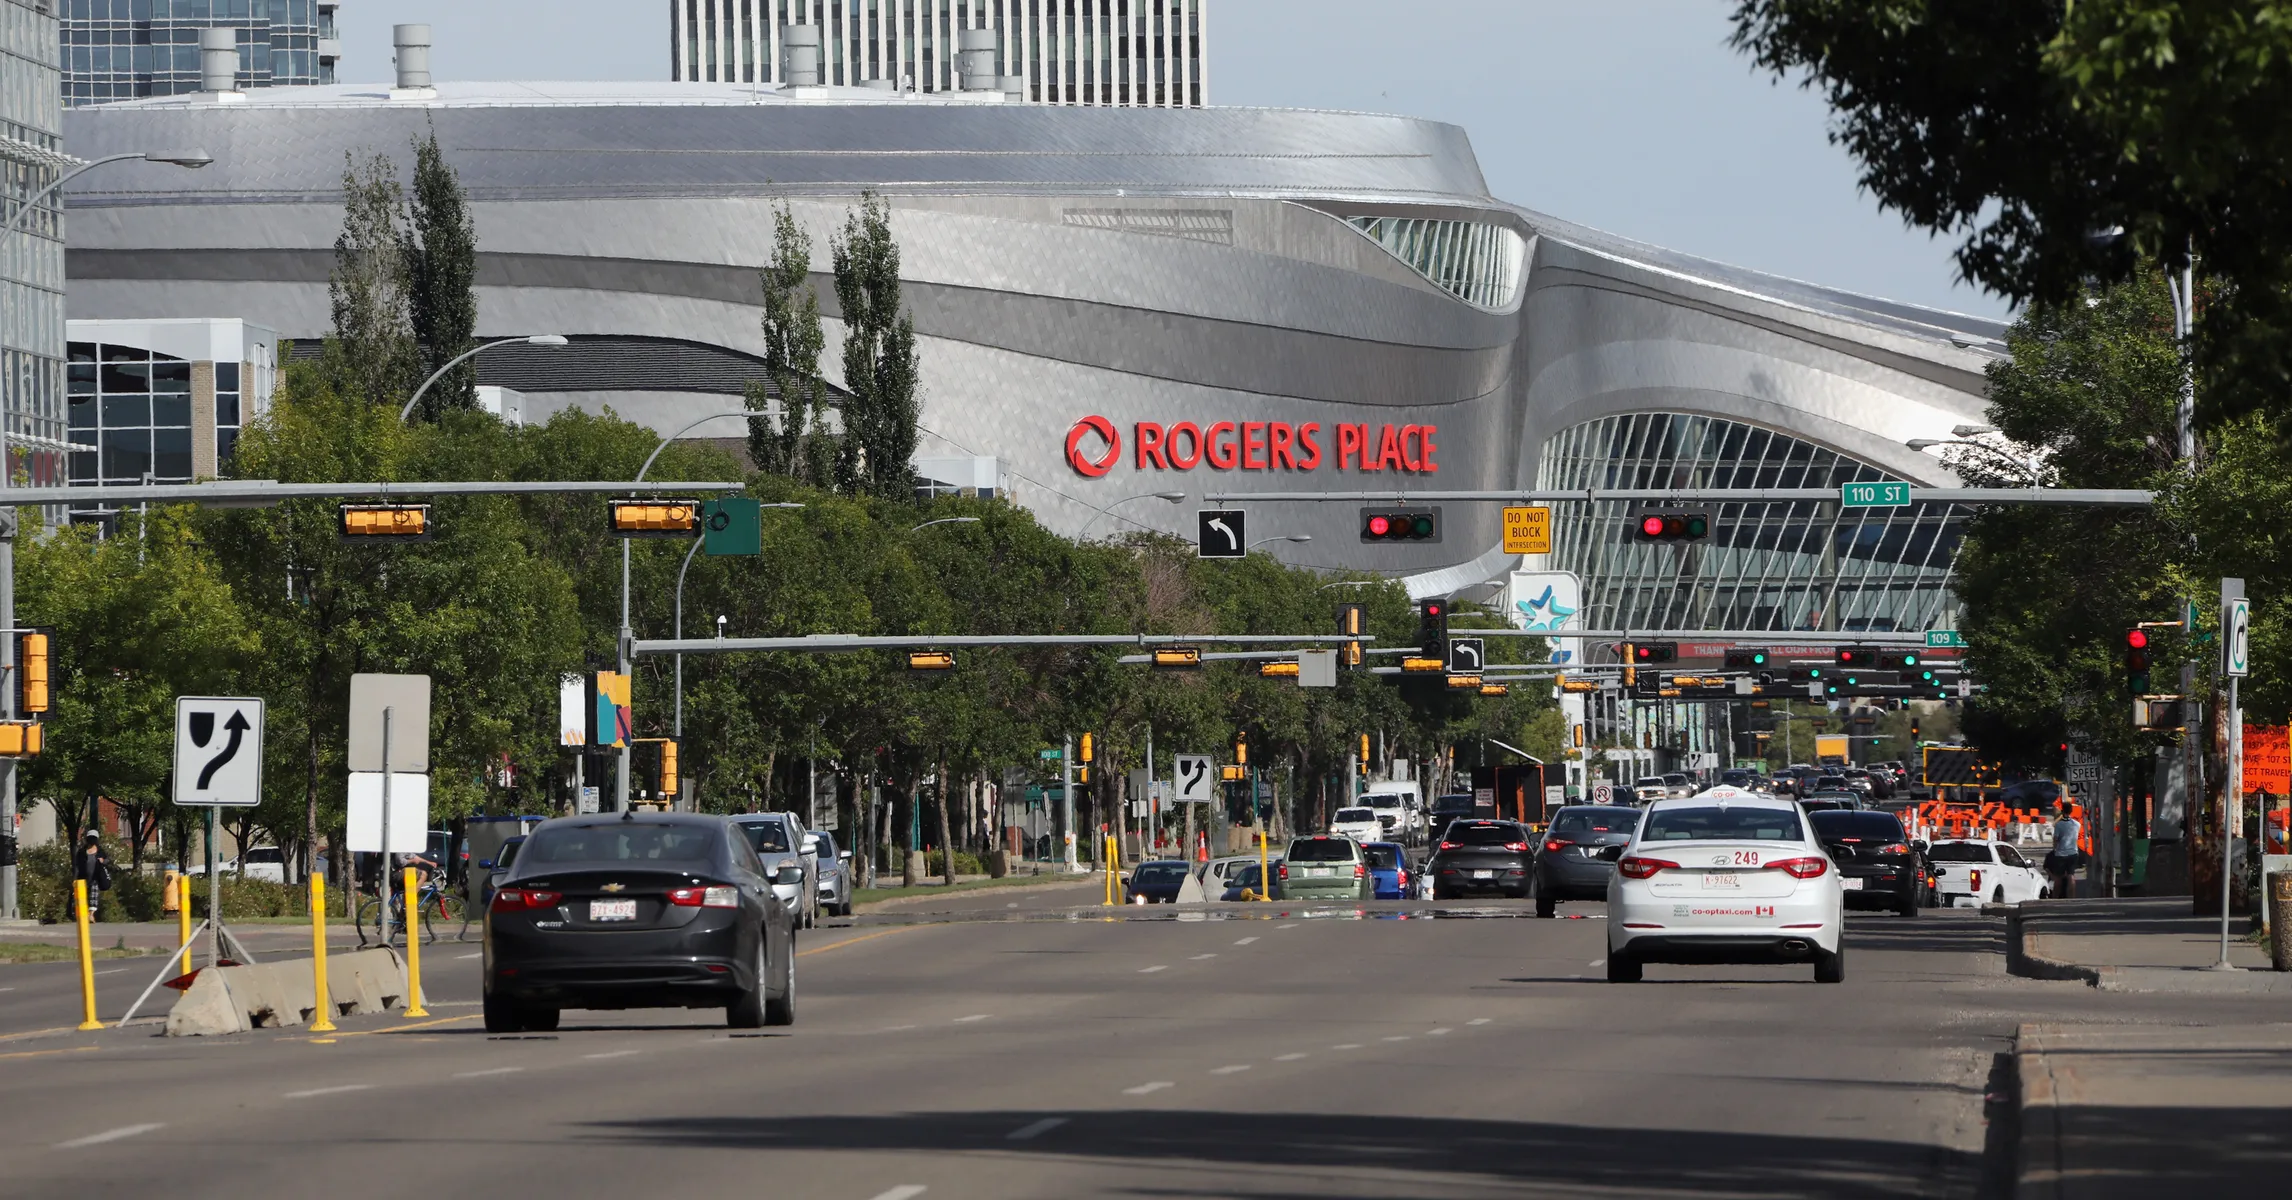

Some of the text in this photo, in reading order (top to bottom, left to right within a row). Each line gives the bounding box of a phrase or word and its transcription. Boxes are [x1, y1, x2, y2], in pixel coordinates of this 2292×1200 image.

[1135, 421, 1439, 473] ROGERS PLACE
[1852, 486, 1902, 502] 110 ST
[1507, 512, 1545, 523] DO NOT
[1512, 527, 1541, 538] BLOCK
[1506, 541, 1547, 549] INTERSECTION
[1931, 633, 1950, 644] 109
[1693, 646, 1725, 655] THANK
[2272, 741, 2278, 750] 9
[2244, 754, 2259, 763] AVE
[2267, 755, 2281, 764] 107
[2260, 768, 2289, 777] TRAVEL
[1734, 851, 1759, 865] 249
[1705, 875, 1738, 885] K-97622
